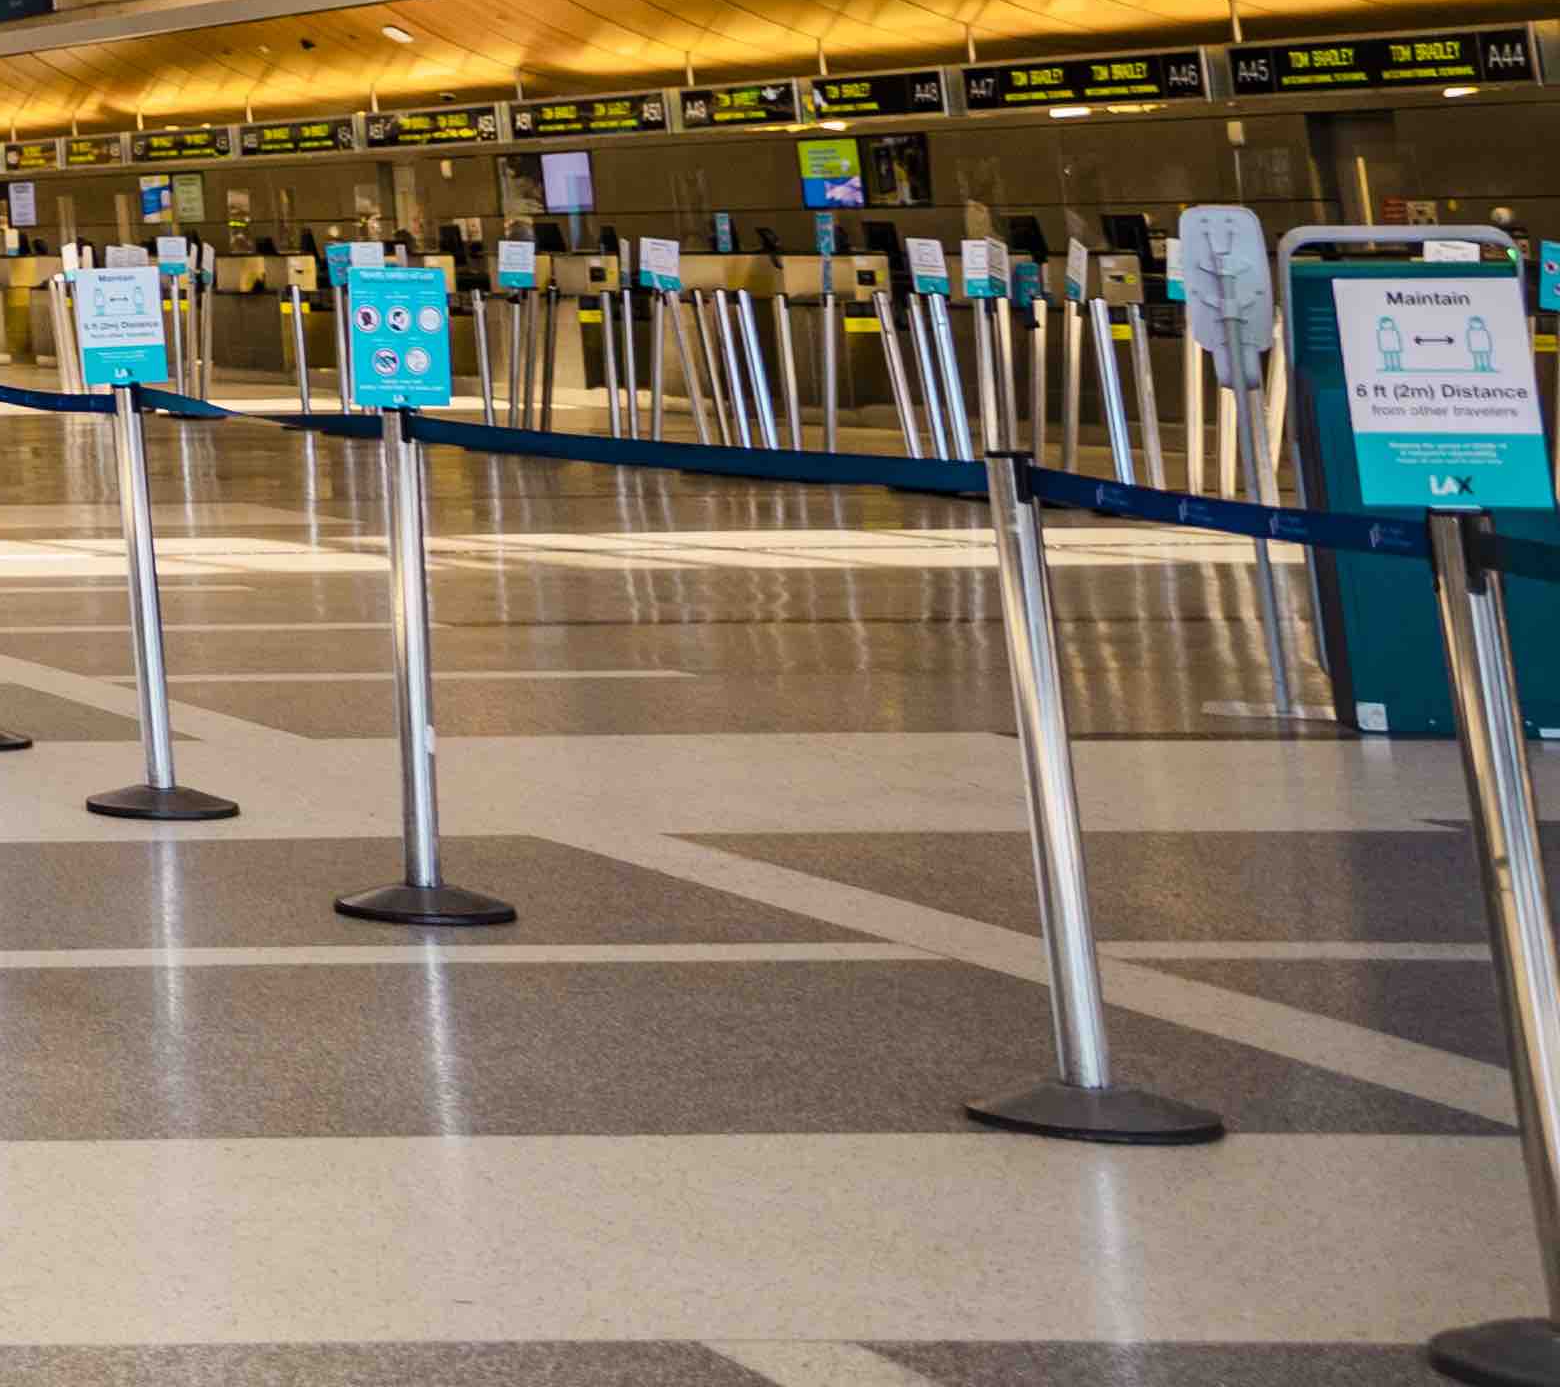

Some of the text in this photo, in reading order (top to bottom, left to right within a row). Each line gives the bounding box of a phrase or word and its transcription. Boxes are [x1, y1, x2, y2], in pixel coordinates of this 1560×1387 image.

[1487, 42, 1525, 67] A44
[1168, 65, 1197, 86] A46
[1237, 60, 1268, 82] A45
[1386, 291, 1470, 306] Maintain
[1356, 384, 1528, 401] 6 ft (2m) Distance
[1372, 405, 1518, 418] from other travelers
[1429, 475, 1473, 495] LAX
